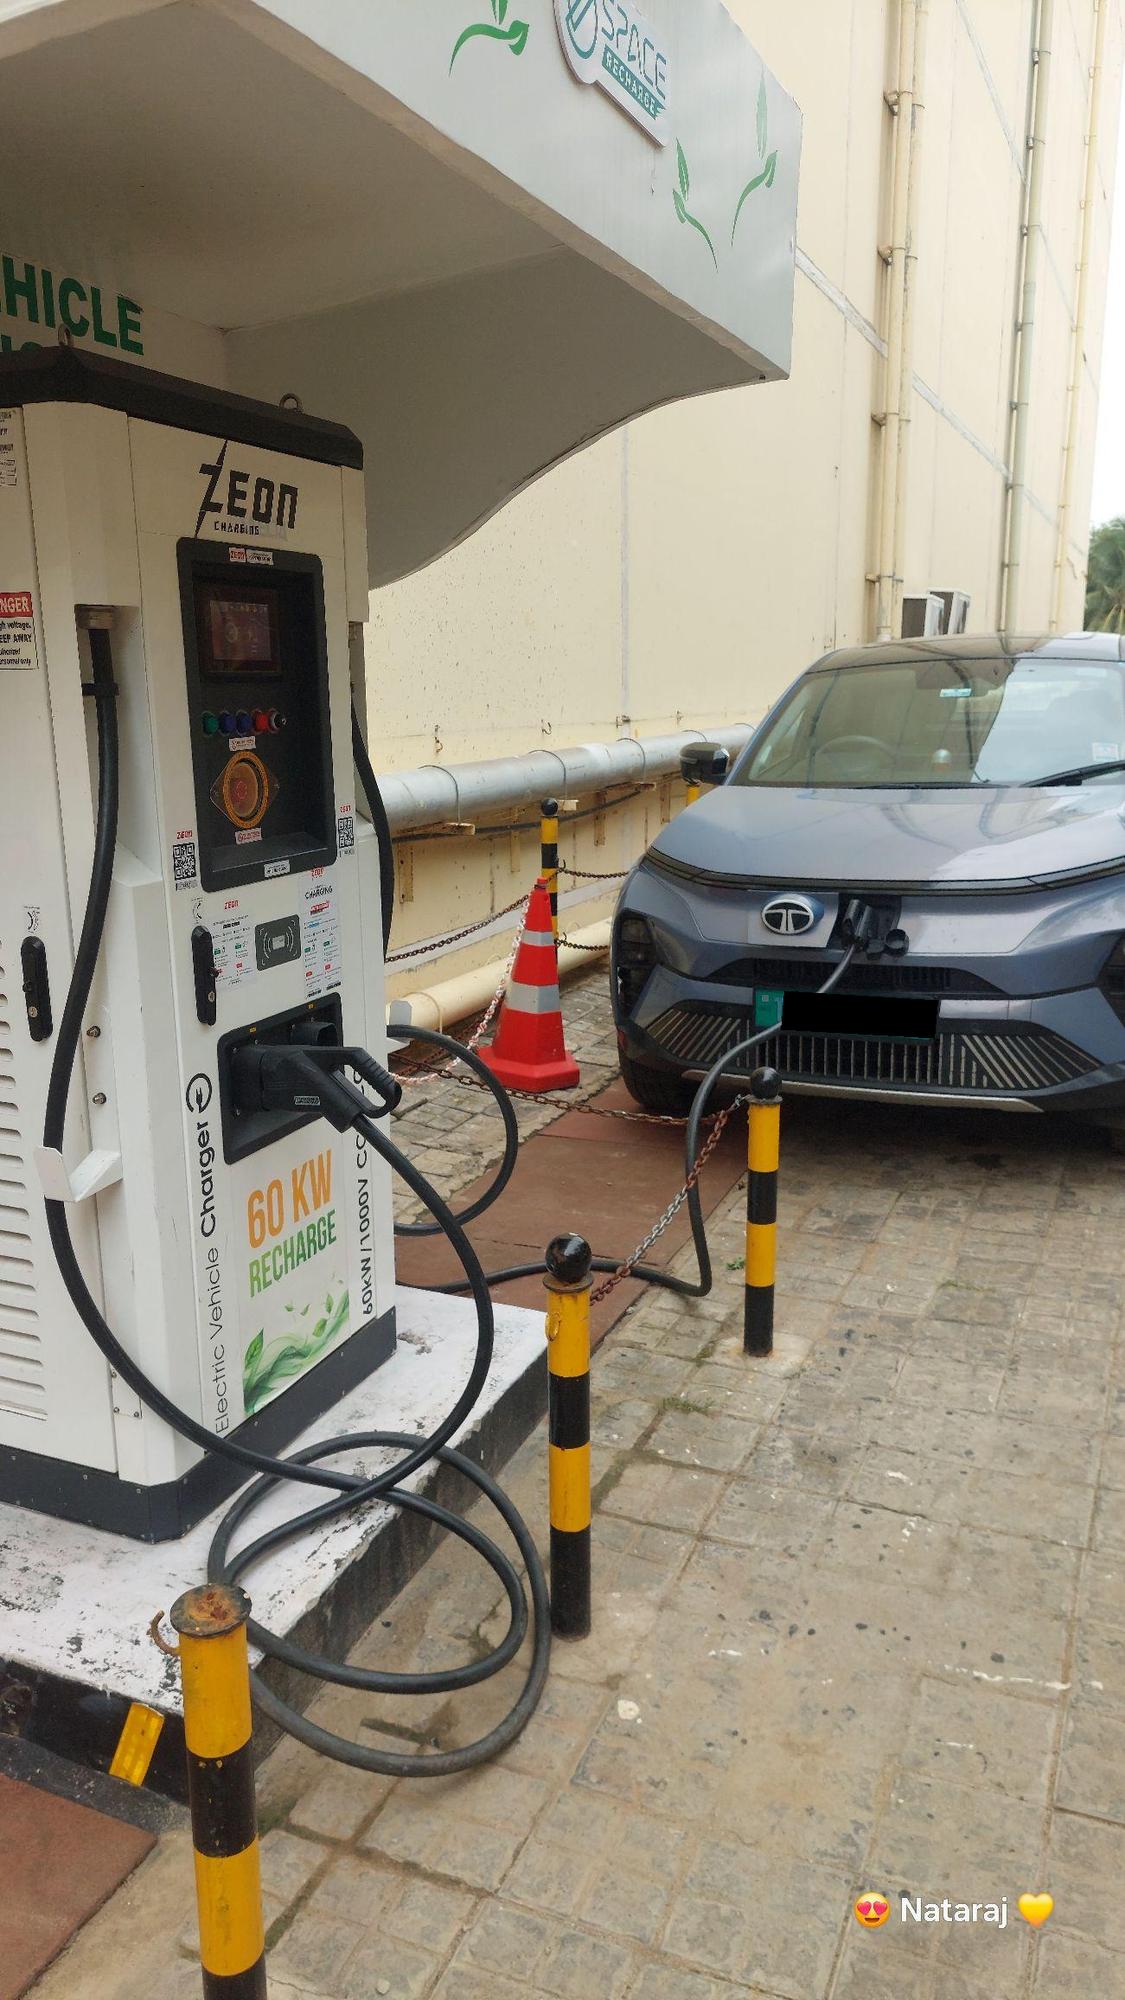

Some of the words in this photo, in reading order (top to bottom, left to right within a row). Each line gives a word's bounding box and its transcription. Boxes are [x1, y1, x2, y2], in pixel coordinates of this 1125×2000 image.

[601, 0, 666, 100] SPACE
[606, 52, 657, 116] RECHARGE
[0, 254, 144, 356] HICLE
[196, 440, 298, 536] ZEON
[214, 521, 260, 535] CHARGING
[13, 633, 32, 643] AWAY
[305, 886, 333, 899] CHARGING
[197, 1121, 215, 1238] Charger
[248, 1179, 284, 1249] 60
[291, 1149, 332, 1223] KW
[206, 1247, 223, 1340] Vehicle
[249, 1209, 337, 1298] RECHARGE
[212, 1344, 229, 1434] Electric
